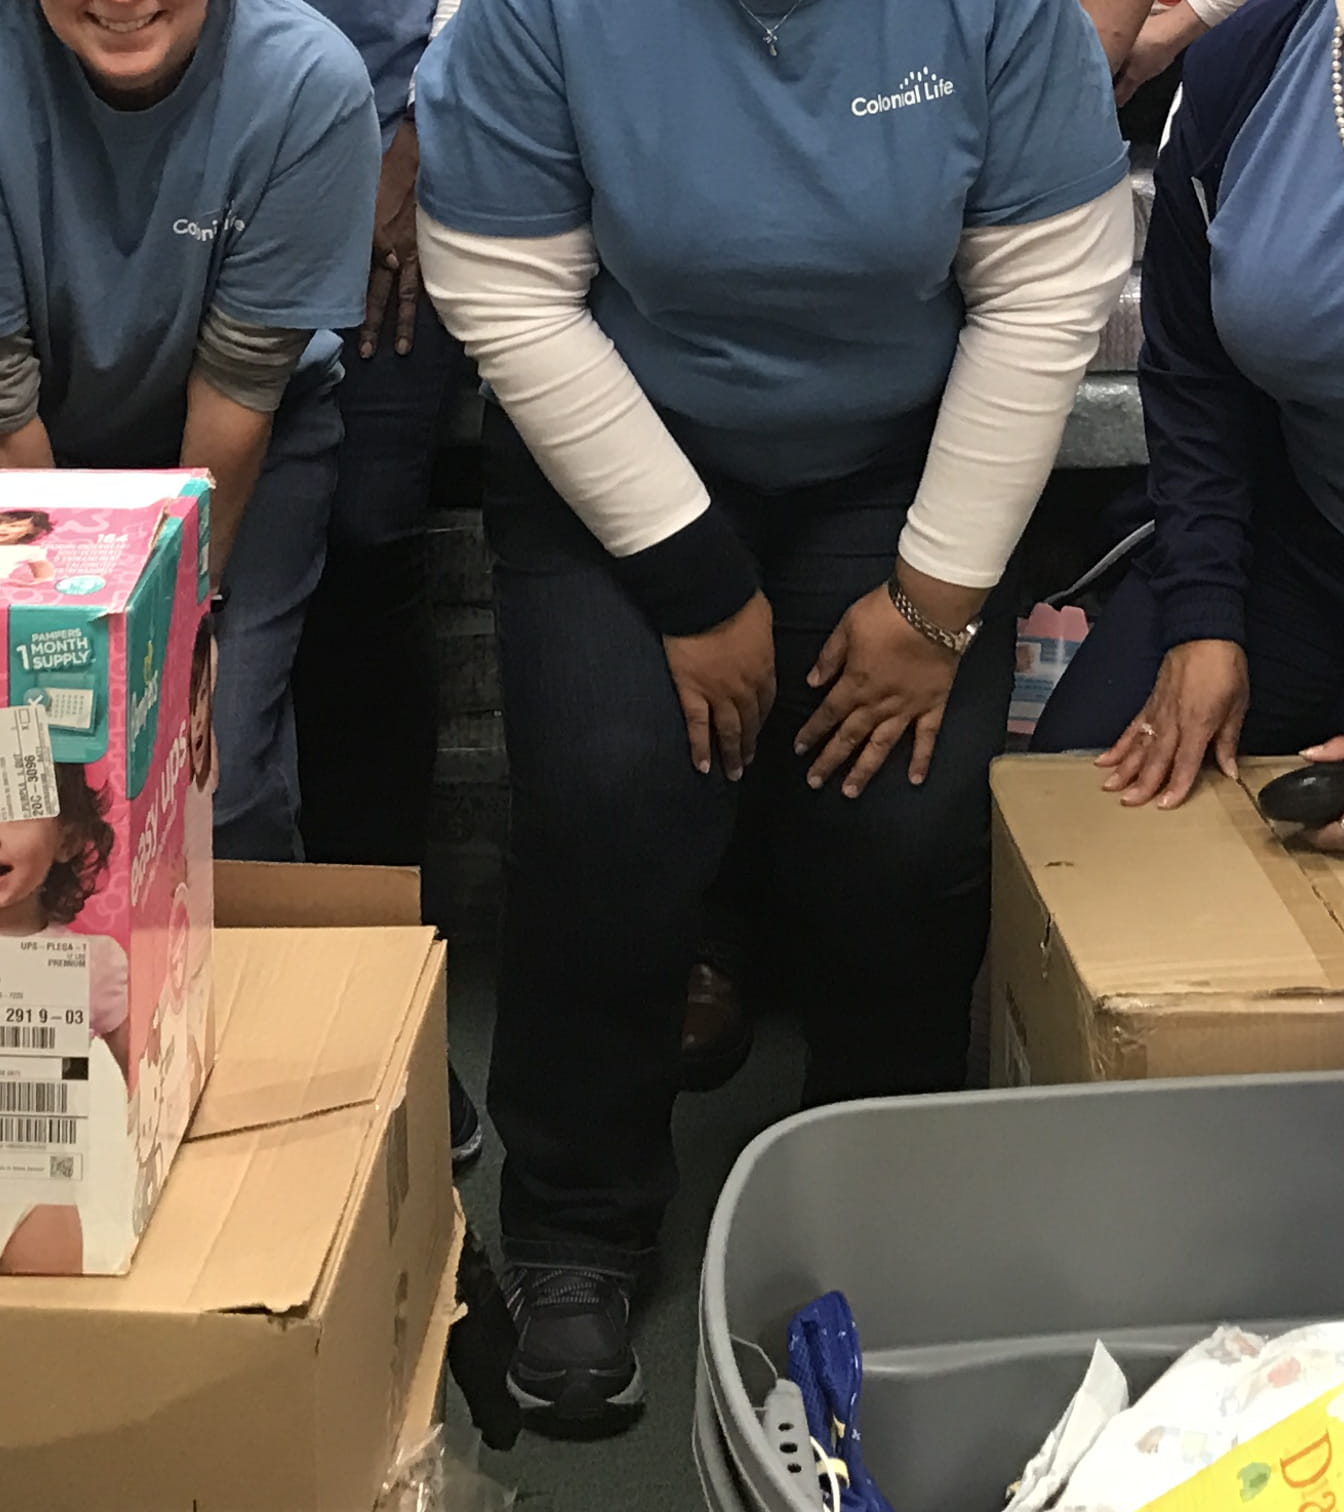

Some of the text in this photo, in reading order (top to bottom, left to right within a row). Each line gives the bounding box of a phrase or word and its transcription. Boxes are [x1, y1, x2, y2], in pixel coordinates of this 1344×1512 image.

[851, 79, 954, 117] Colonial Life
[31, 628, 82, 642] PAMPERS
[16, 637, 89, 670] 1 MONTH
[32, 649, 91, 670] SUPPLY
[160, 719, 187, 815] ups
[20, 941, 38, 951] UPS
[5, 1007, 33, 1023] 291
